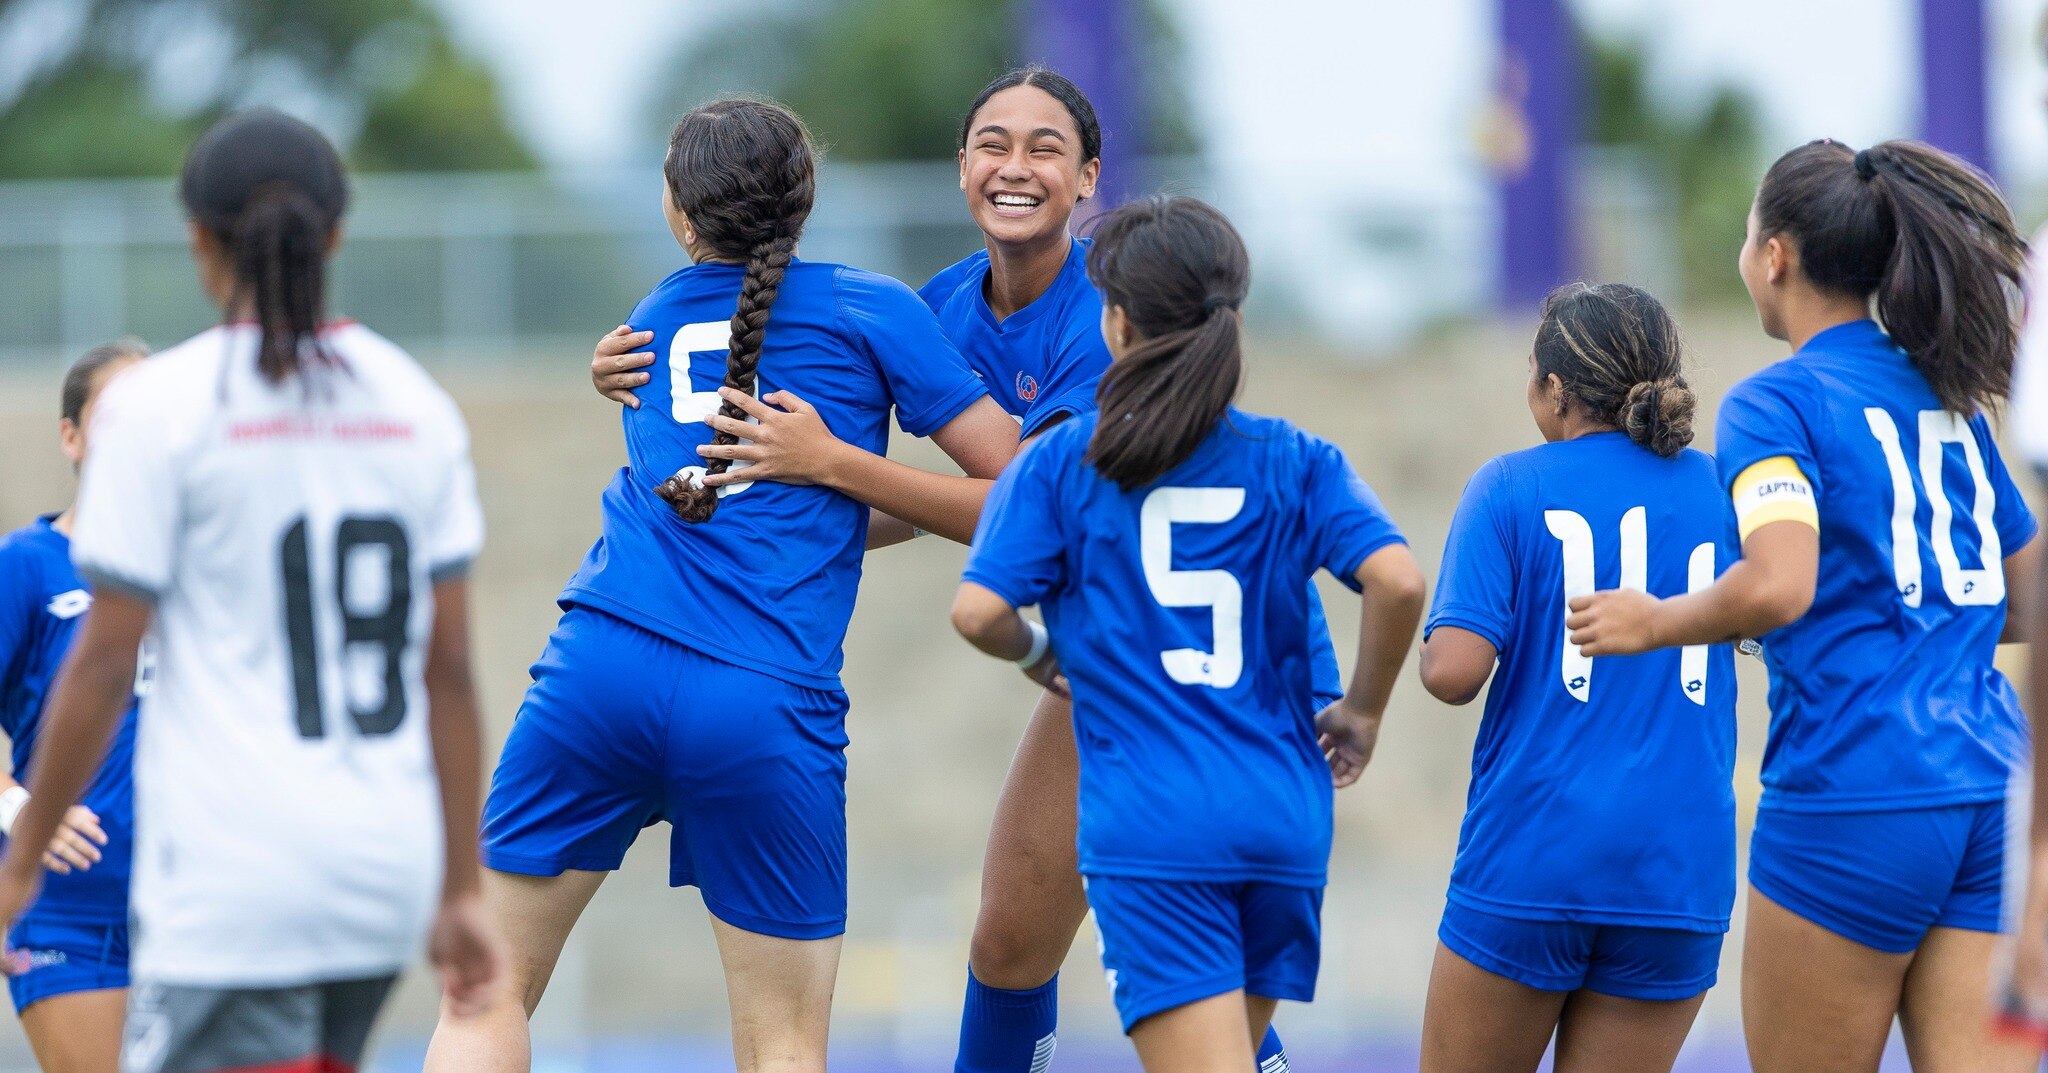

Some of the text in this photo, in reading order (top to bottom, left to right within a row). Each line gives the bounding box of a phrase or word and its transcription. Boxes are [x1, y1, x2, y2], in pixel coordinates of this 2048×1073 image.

[1140, 486, 1246, 689] 5
[1544, 506, 1716, 706] 14
[1863, 407, 2006, 609] 10
